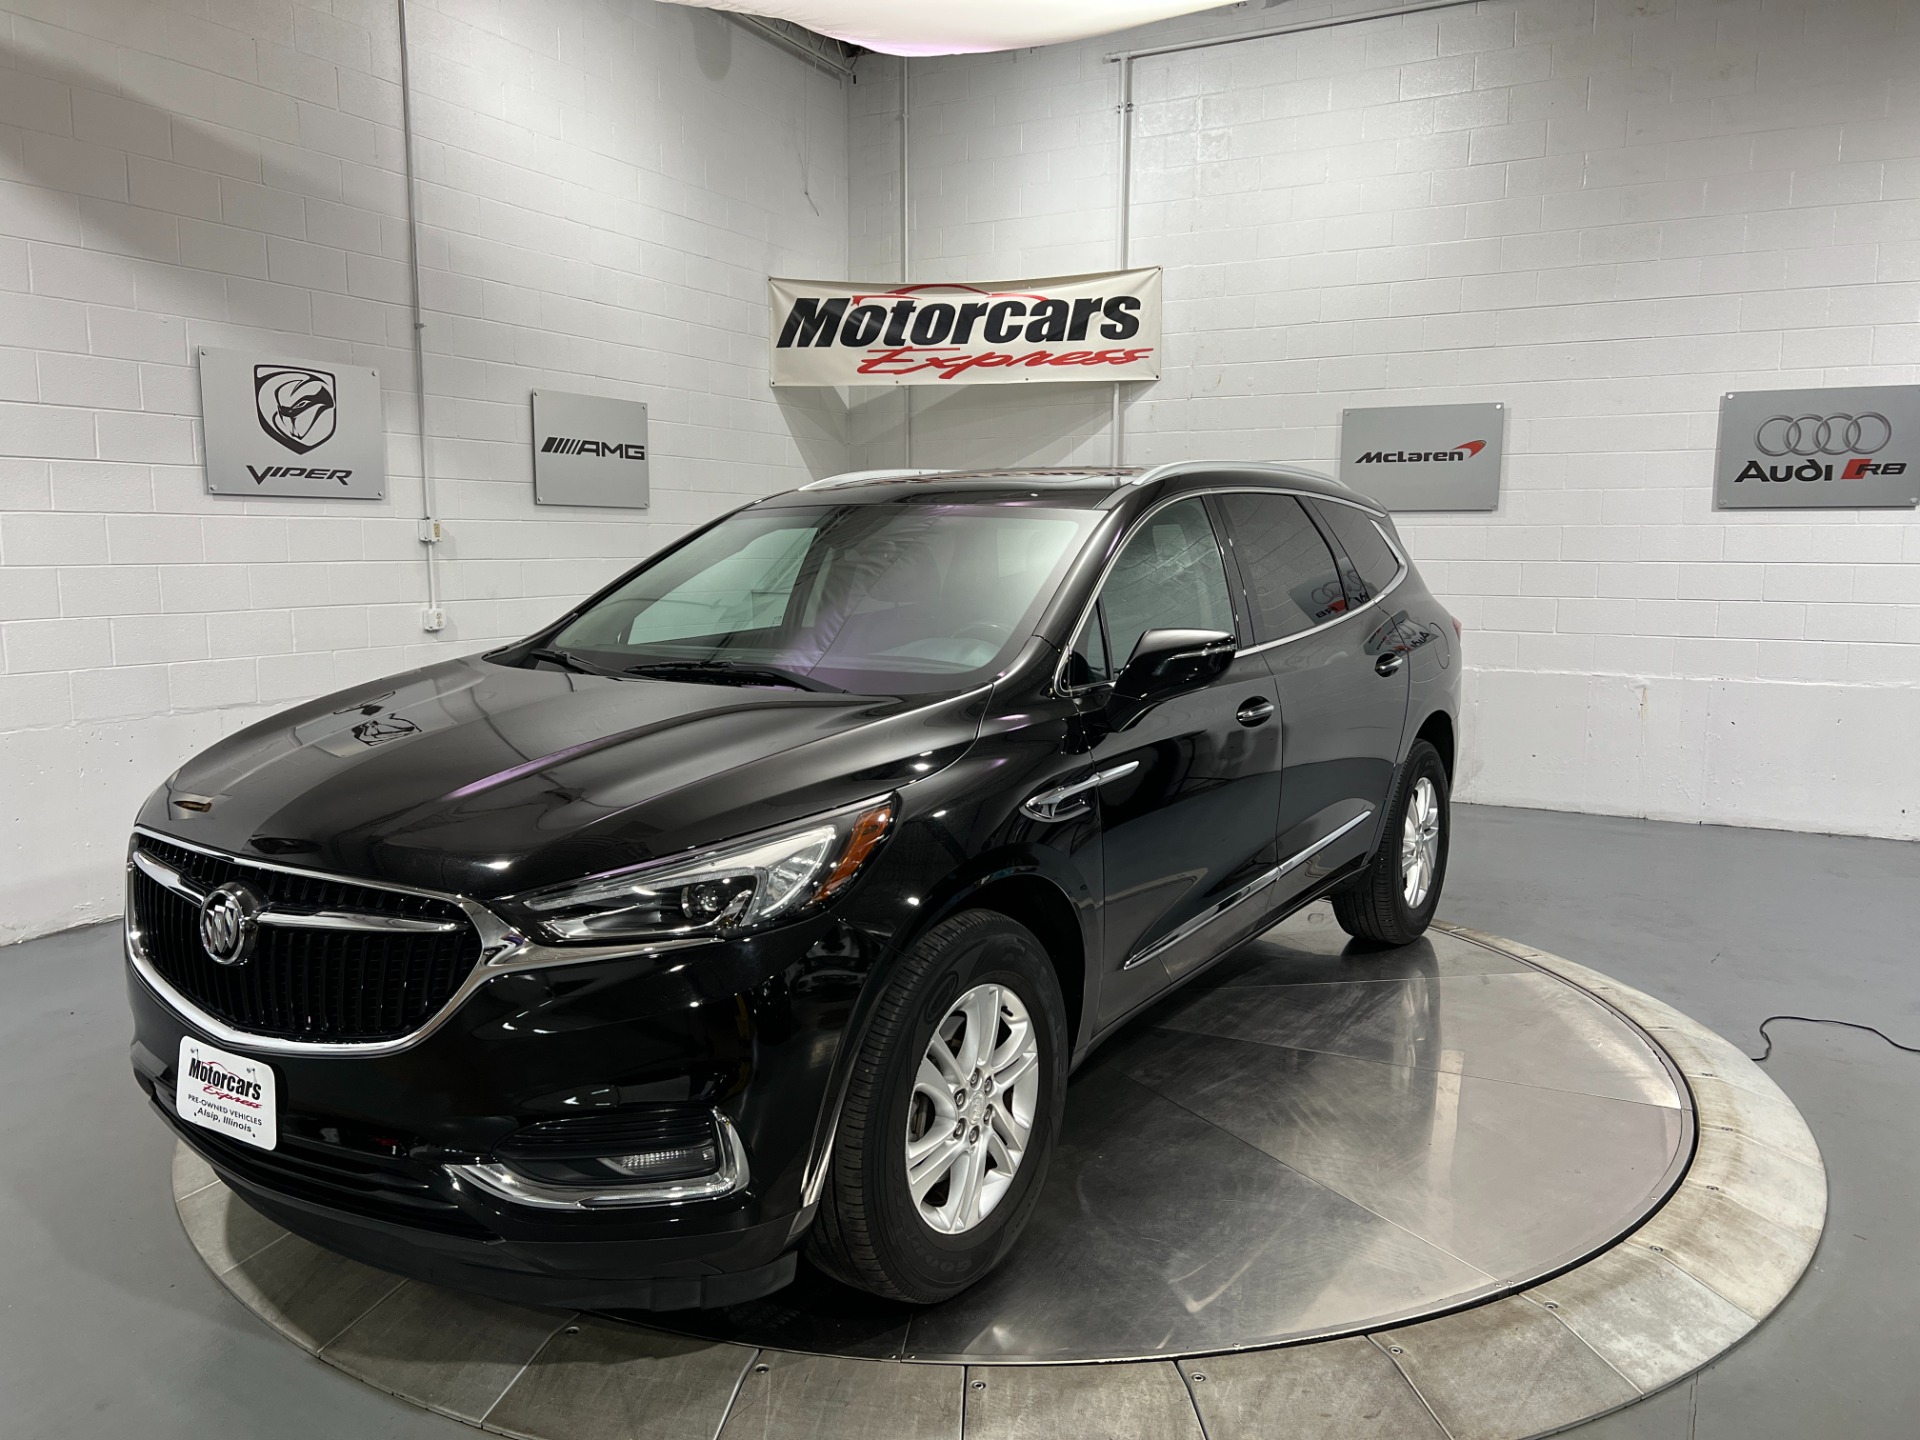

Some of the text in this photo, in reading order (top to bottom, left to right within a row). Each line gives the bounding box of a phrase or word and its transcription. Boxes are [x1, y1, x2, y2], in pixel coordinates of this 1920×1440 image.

[776, 295, 1142, 348] Motorcars
[857, 346, 1154, 380] Express
[1355, 451, 1464, 464] McLaren
[246, 465, 353, 486] VIPER
[1734, 459, 1907, 482] Audi R8
[188, 1058, 262, 1100] Motorcars
[203, 1084, 262, 1109] Express
[188, 1094, 262, 1126] PRE-OWNED VEHICLES
[198, 1107, 252, 1132] Alsip, Illinois
